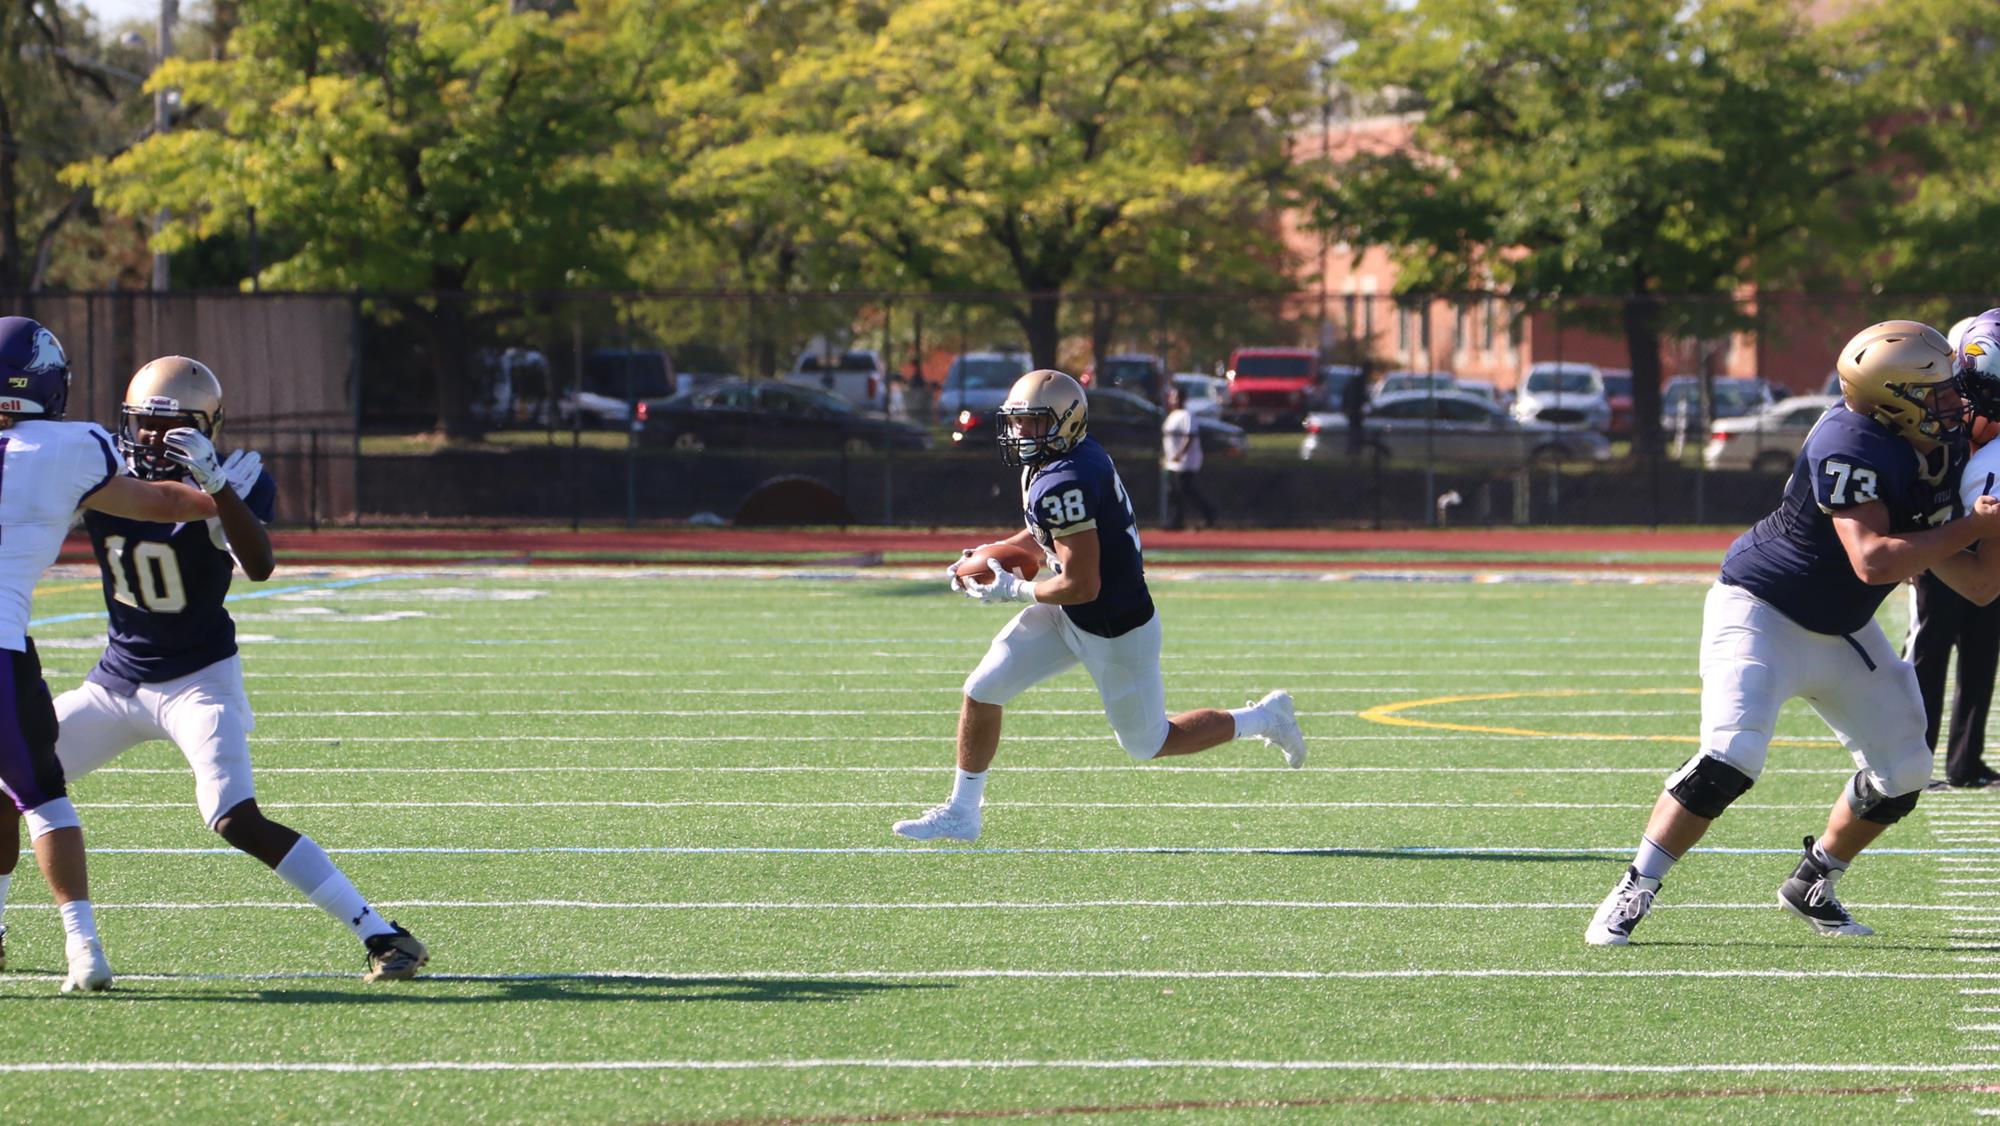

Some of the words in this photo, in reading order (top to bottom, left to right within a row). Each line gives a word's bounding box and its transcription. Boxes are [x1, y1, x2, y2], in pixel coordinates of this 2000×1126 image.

[1825, 460, 1879, 504] 73
[1041, 488, 1086, 525] 38
[104, 535, 187, 613] 10
